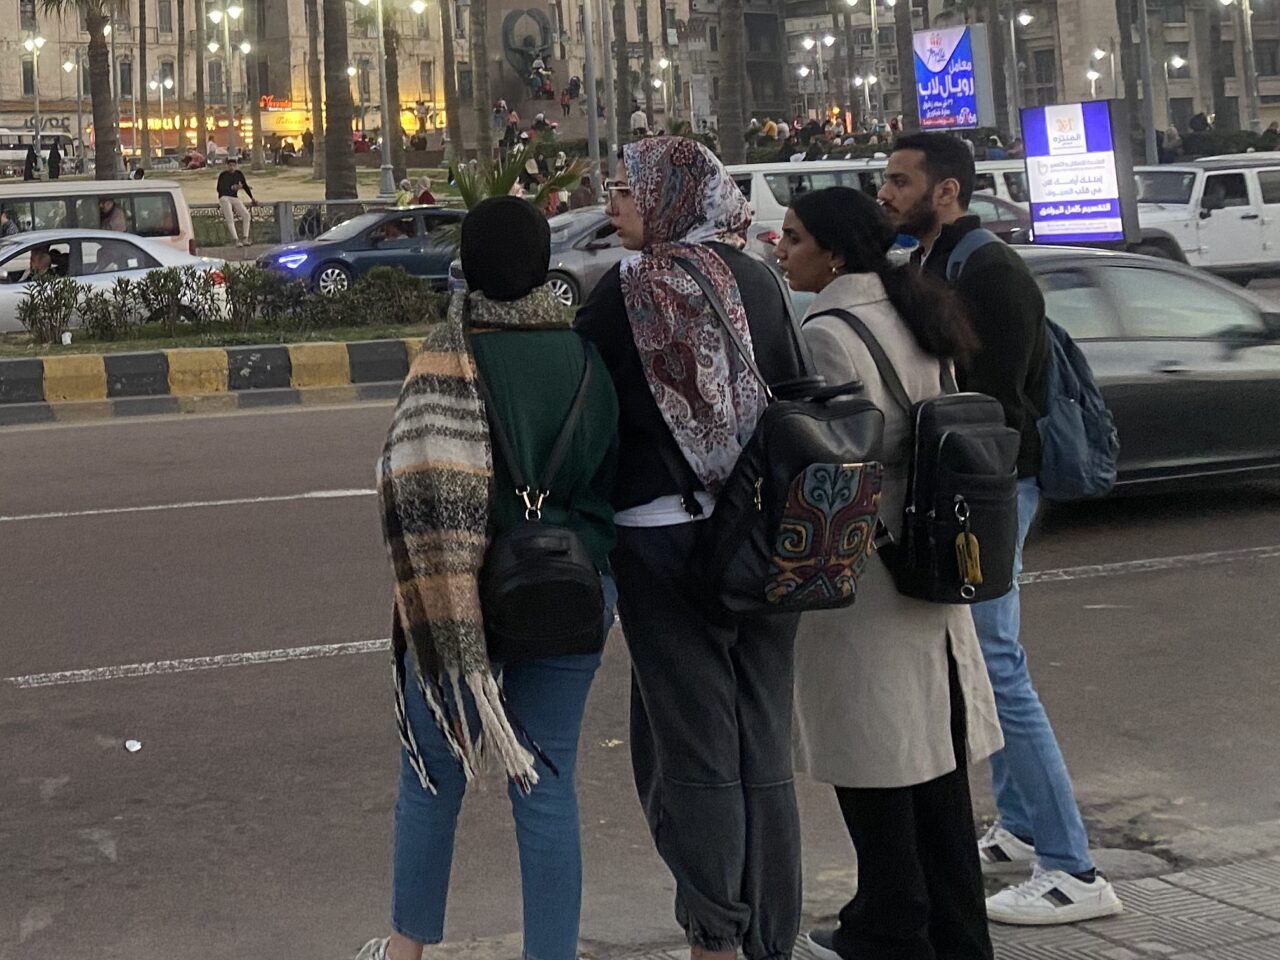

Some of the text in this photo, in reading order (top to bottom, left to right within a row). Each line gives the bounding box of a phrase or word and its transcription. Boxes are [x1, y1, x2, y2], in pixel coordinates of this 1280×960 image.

[949, 58, 972, 74] معامل
[919, 75, 975, 99] رويال لاب
[1082, 203, 1111, 214] التقسيم
